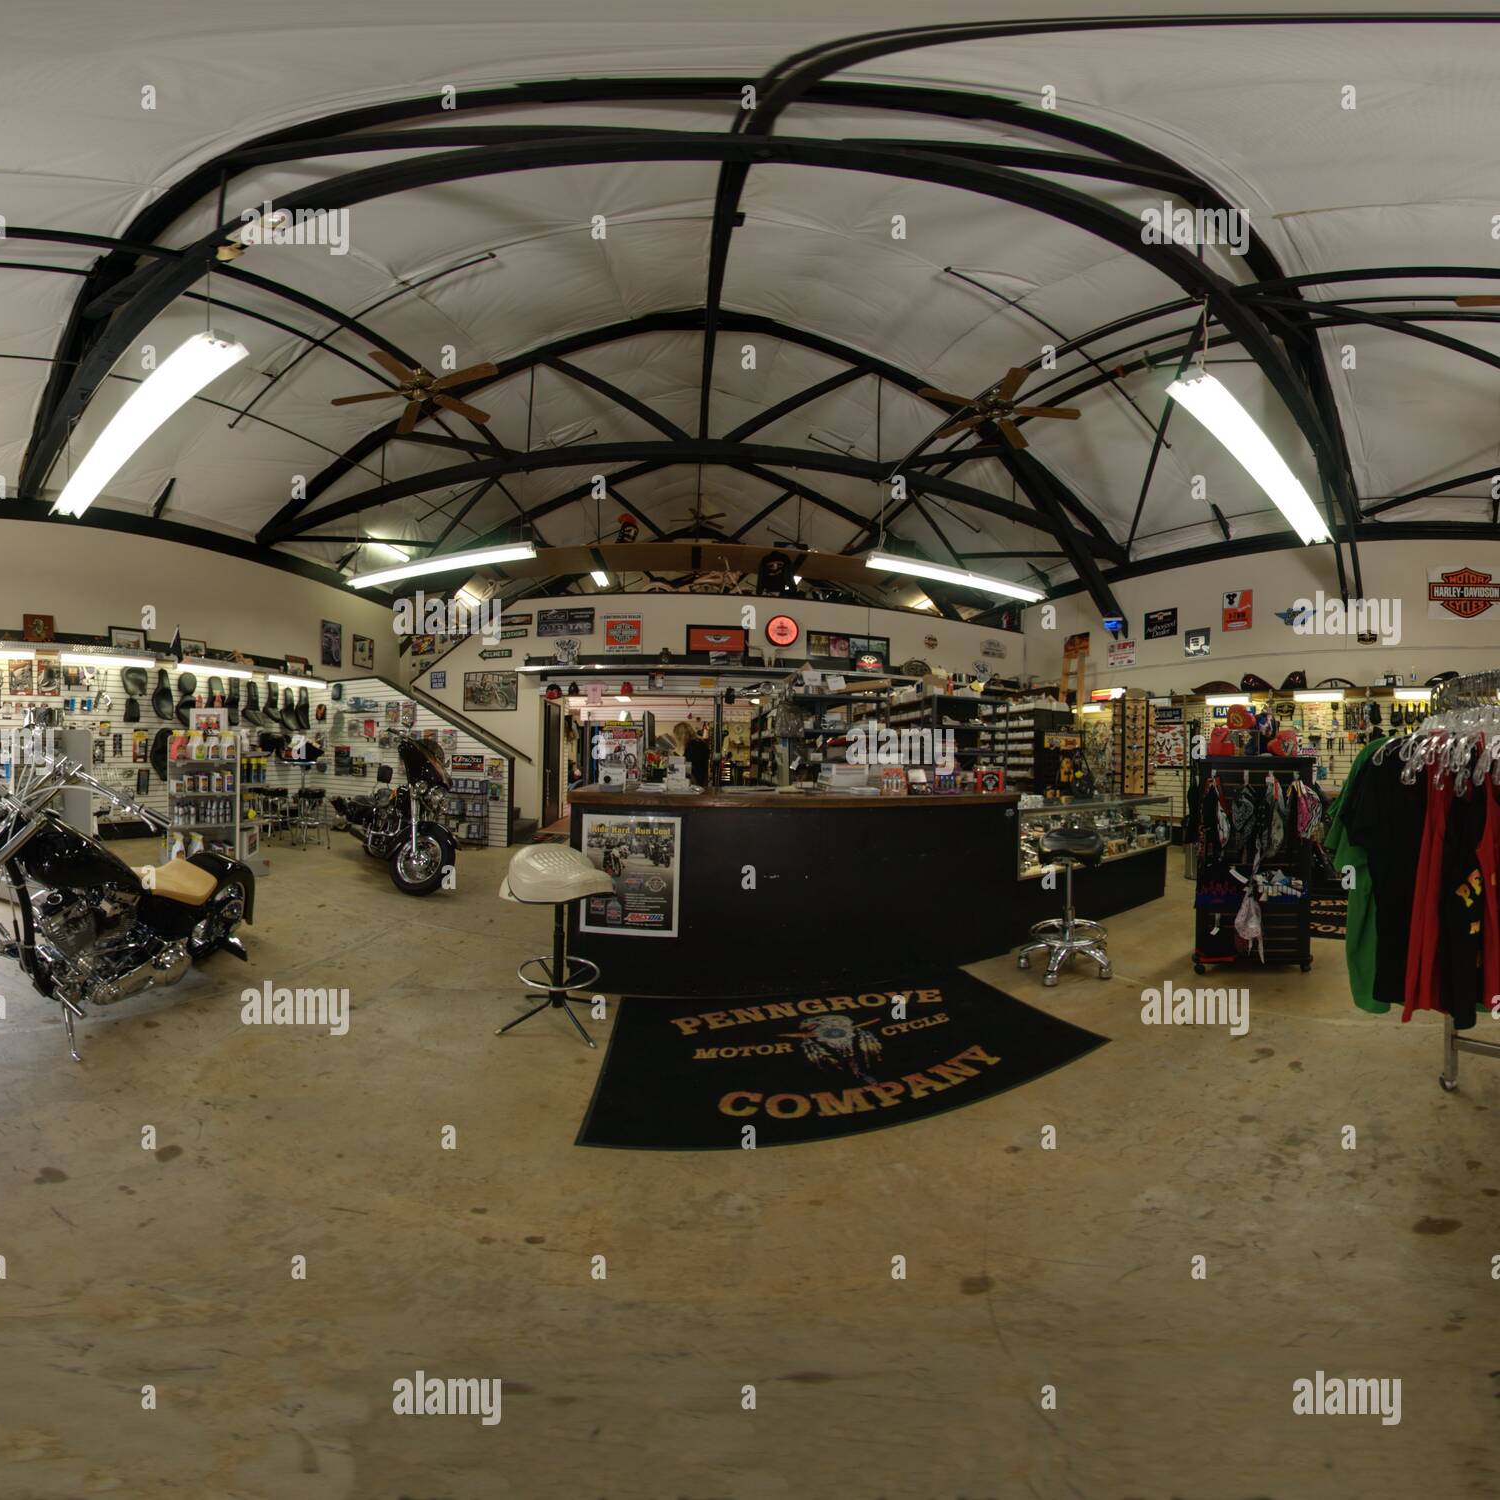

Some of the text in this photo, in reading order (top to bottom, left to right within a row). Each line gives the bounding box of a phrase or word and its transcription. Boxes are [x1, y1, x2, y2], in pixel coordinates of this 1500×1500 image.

[1449, 574, 1485, 583] MOTOR
[1433, 586, 1499, 598] HARLEY-DAVIDSON
[1449, 601, 1485, 610] CYCLES
[1215, 707, 1230, 716] FLAT
[590, 823, 609, 833] Ride
[635, 827, 651, 835] Run
[669, 988, 943, 1036] PENNGROVE
[693, 1012, 951, 1060] MOTOR CYCLE
[717, 1044, 1001, 1120] COMPANY
